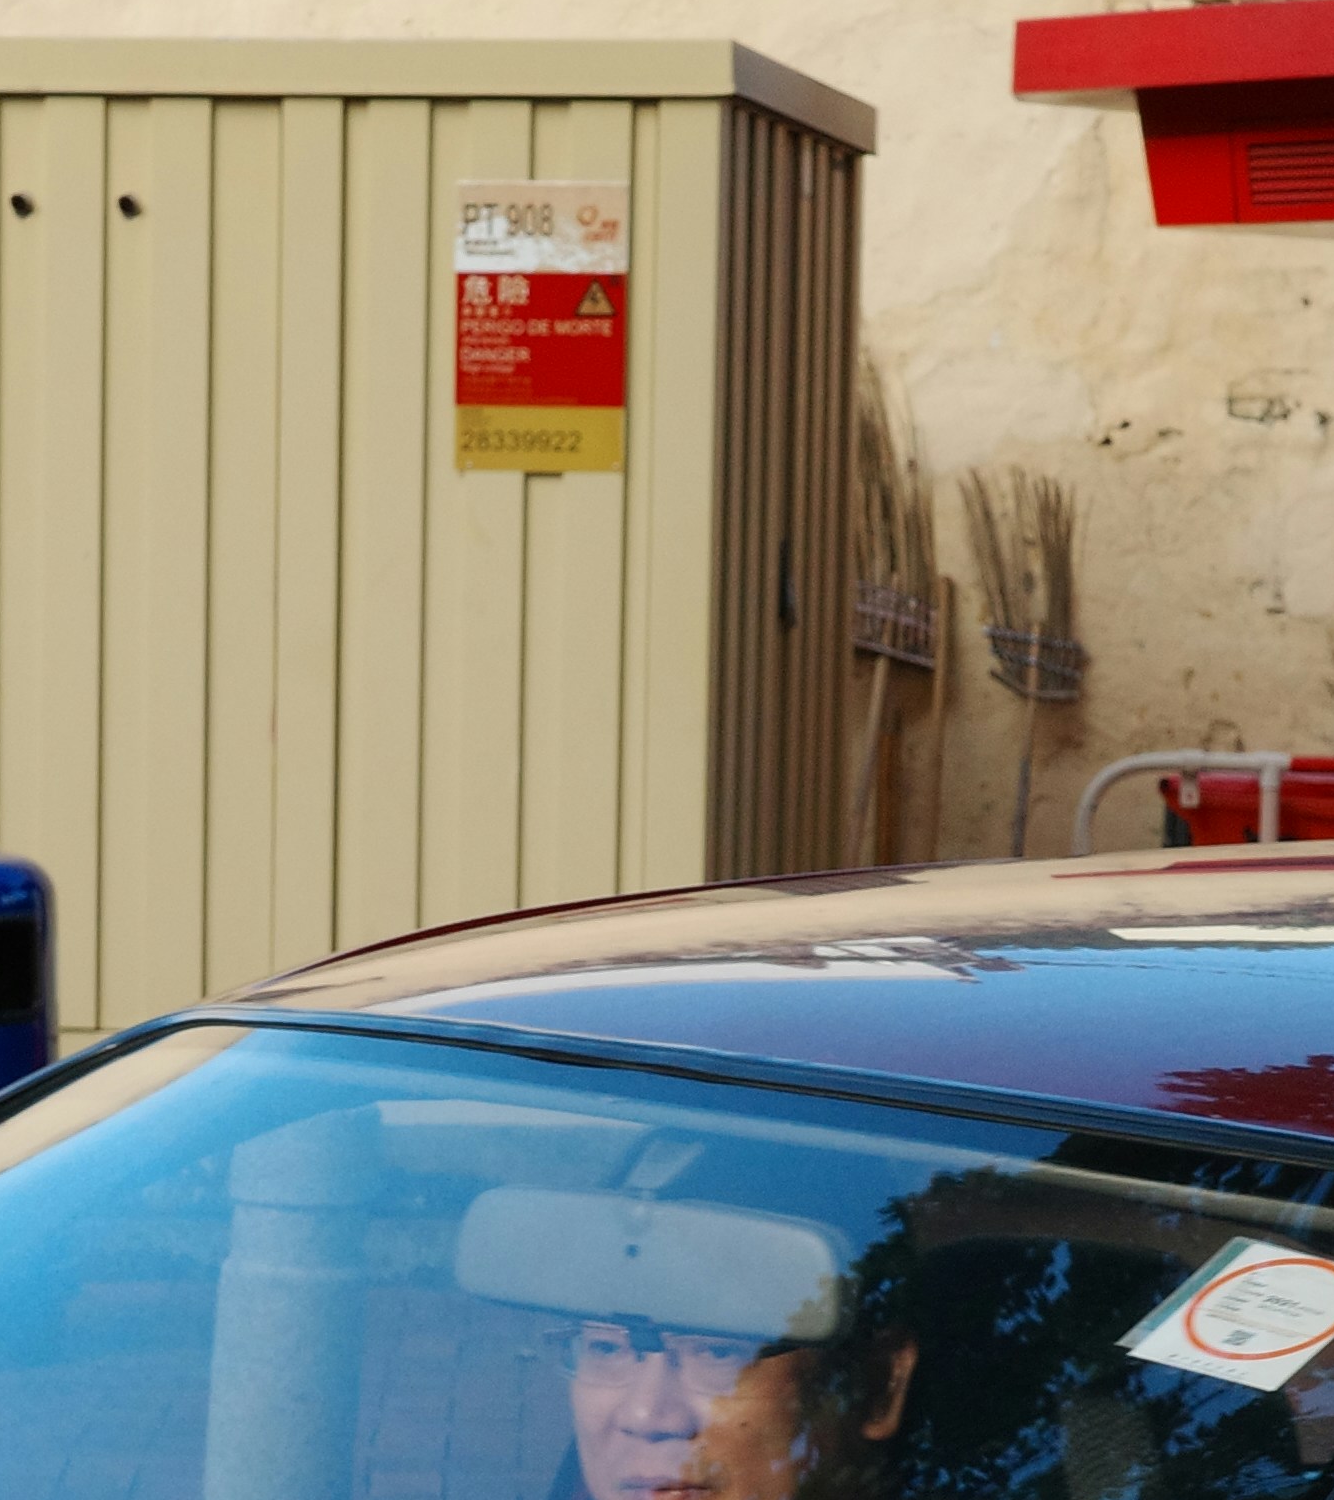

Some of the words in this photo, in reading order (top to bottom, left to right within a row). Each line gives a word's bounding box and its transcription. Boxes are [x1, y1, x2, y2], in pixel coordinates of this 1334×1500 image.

[462, 202, 499, 236] PT
[507, 202, 554, 237] 908
[459, 318, 525, 337] PERIGO
[527, 318, 551, 337] DE
[553, 318, 614, 338] MORTE
[461, 428, 583, 453] 28339922
